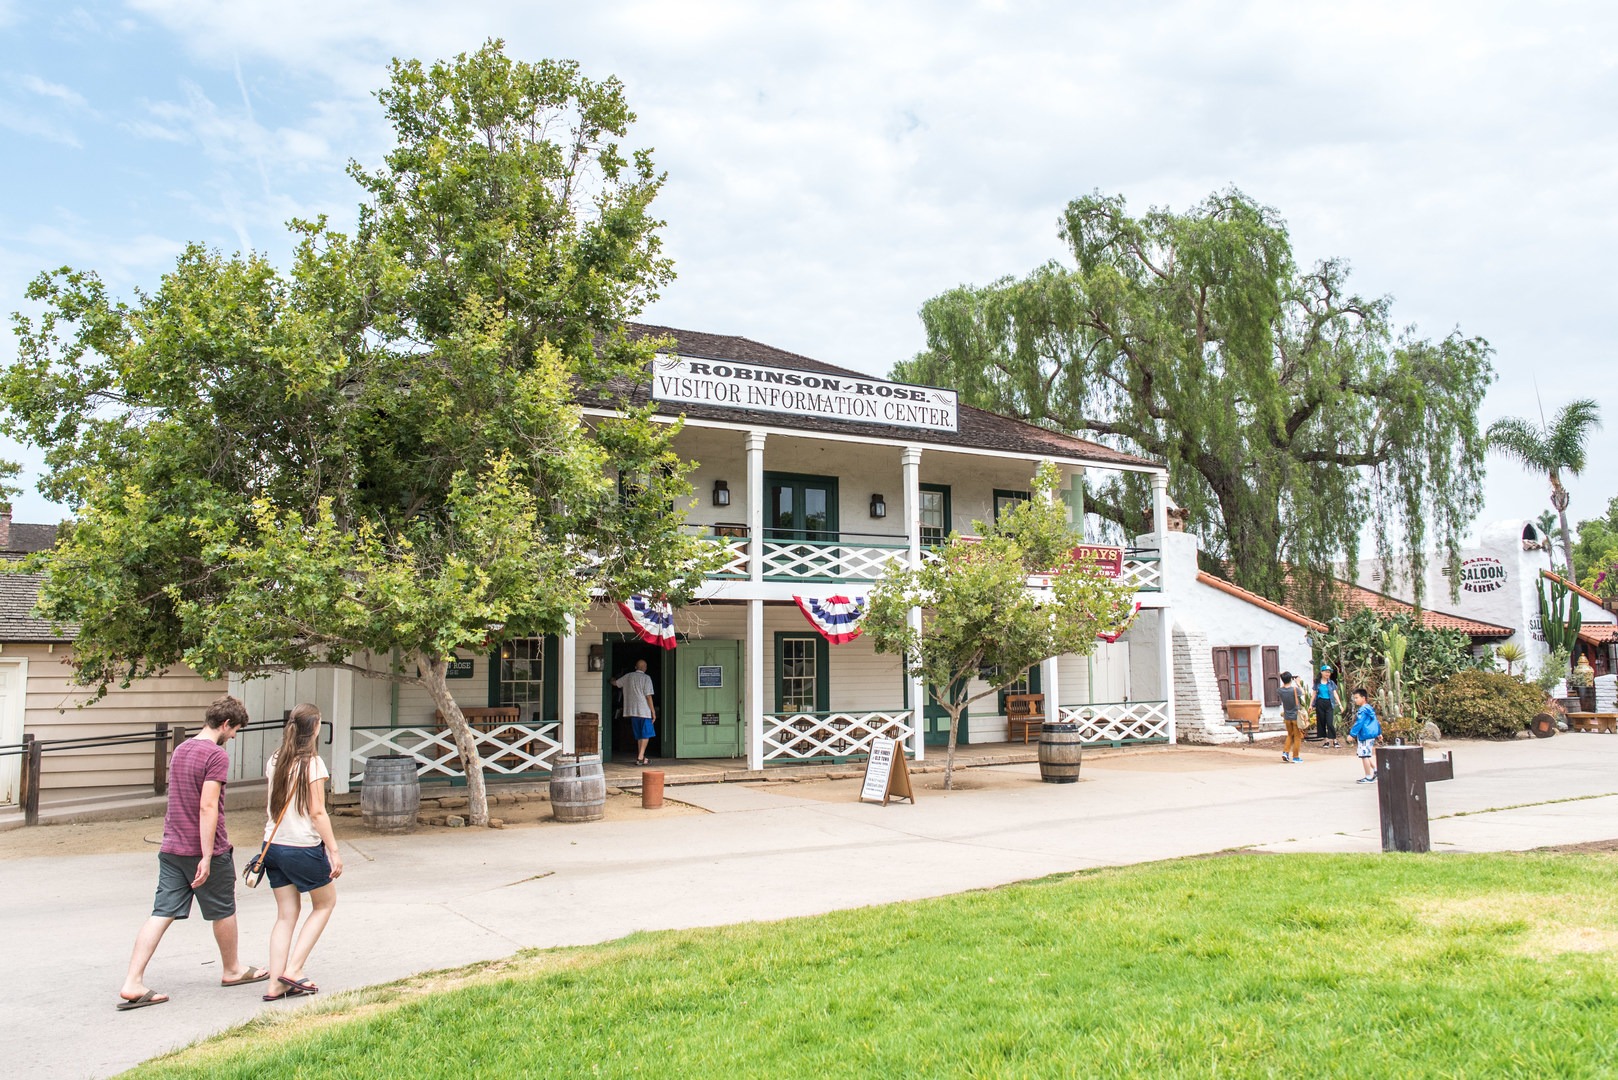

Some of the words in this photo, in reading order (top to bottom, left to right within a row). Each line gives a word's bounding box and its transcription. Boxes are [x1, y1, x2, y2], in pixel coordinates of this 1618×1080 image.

[660, 375, 741, 403] VISITOR
[748, 385, 878, 418] INFORMATION
[1079, 548, 1118, 561] DAYS
[1460, 566, 1503, 580] SALOON
[1529, 619, 1542, 630] SAL
